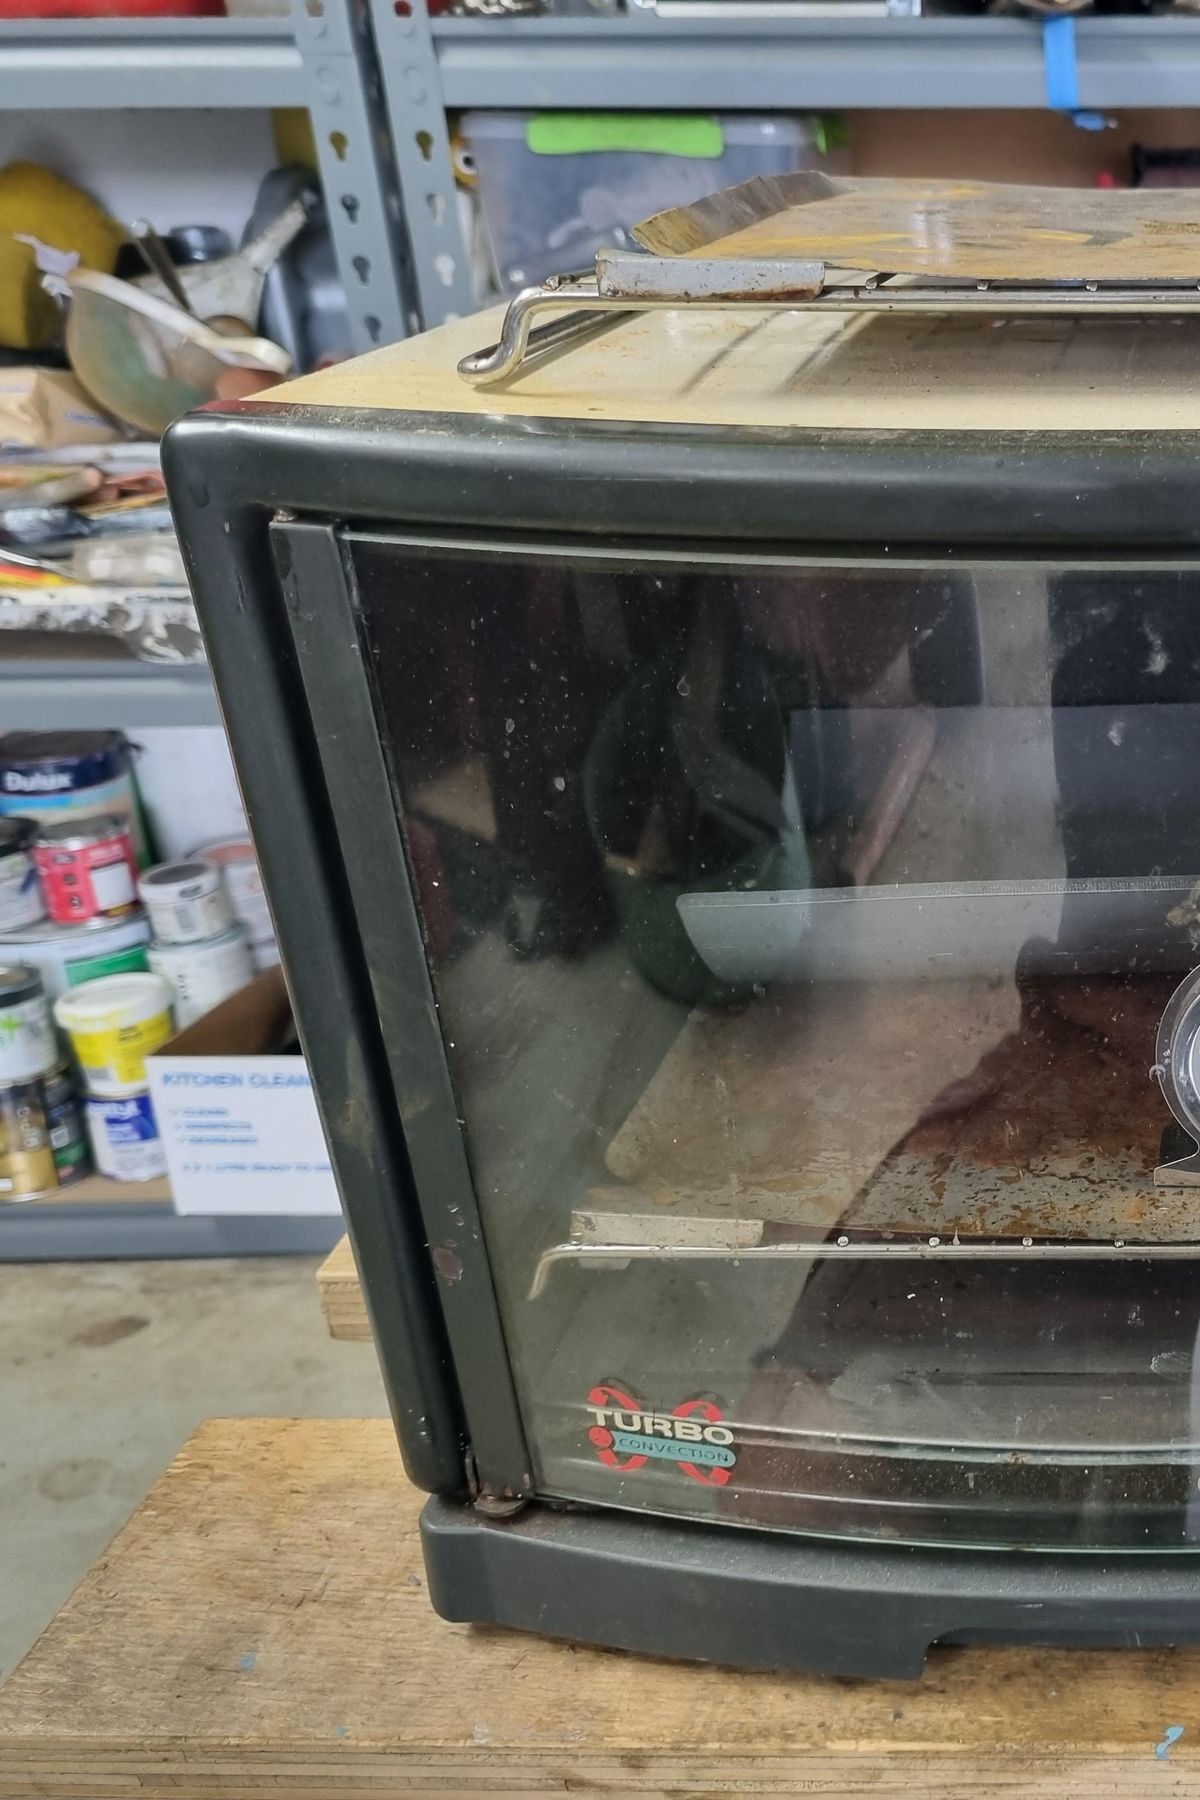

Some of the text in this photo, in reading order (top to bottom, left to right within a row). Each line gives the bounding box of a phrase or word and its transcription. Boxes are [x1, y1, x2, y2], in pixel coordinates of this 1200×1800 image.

[162, 1073, 242, 1086] KITCHEN
[587, 1407, 735, 1446] TURBO
[618, 1437, 729, 1462] CONVECTION
